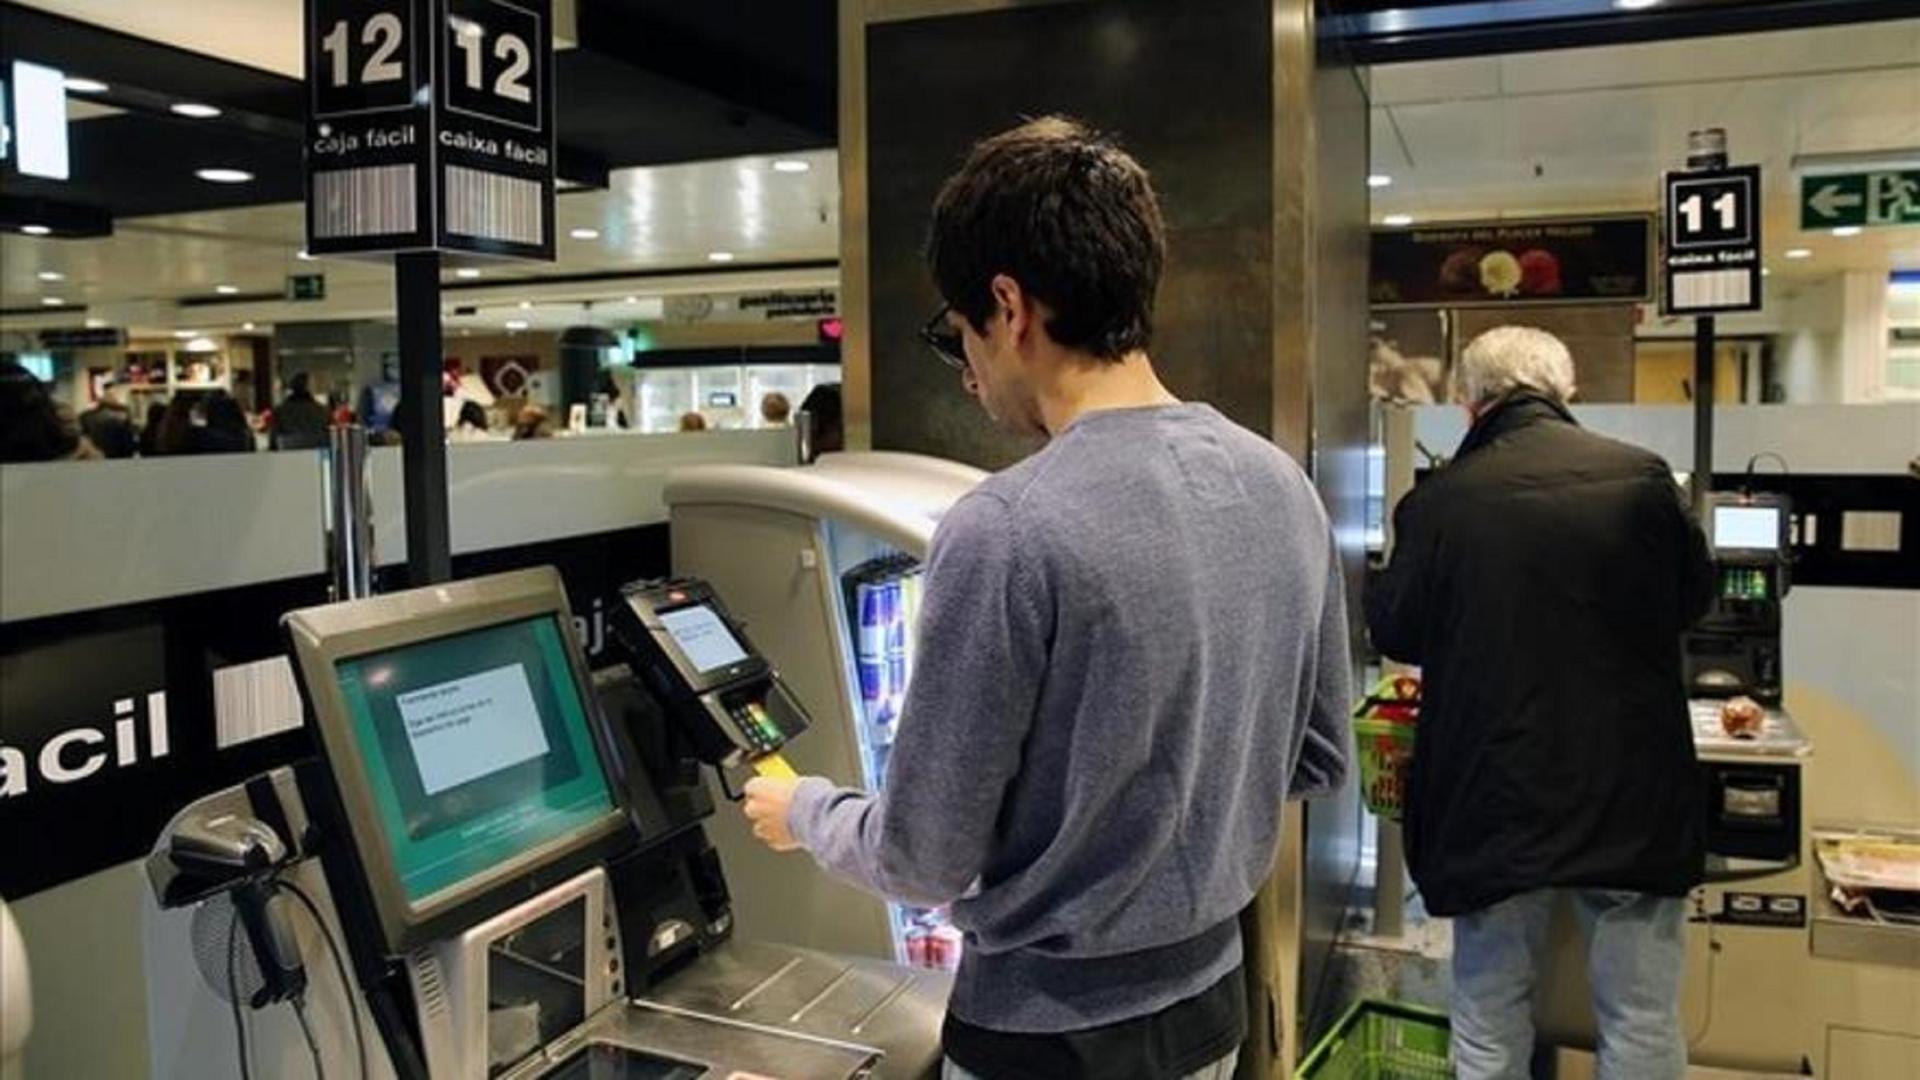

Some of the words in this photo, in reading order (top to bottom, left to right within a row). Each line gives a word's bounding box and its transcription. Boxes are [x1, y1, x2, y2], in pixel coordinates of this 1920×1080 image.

[323, 12, 402, 87] 12
[455, 22, 531, 102] 12
[314, 131, 358, 155] caja
[439, 130, 498, 155] caixa
[1679, 192, 1735, 232] 11
